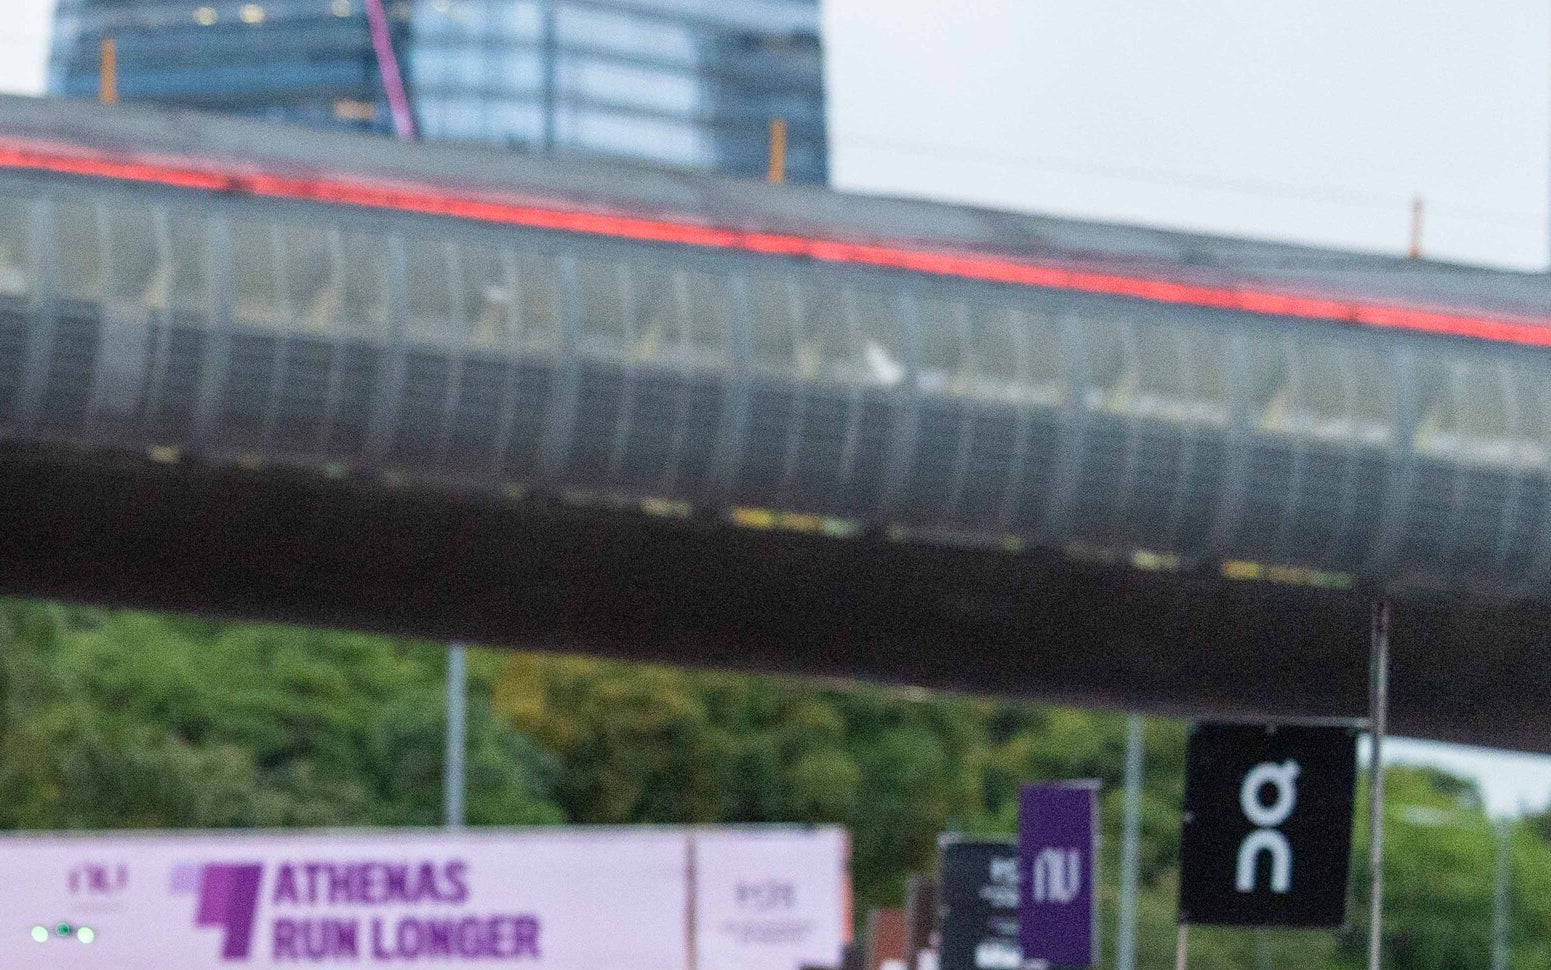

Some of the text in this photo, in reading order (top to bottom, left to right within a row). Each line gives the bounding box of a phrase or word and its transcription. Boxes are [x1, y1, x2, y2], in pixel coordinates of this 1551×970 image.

[271, 858, 470, 904] ATHENAS
[272, 915, 543, 962] RUN LONGER
